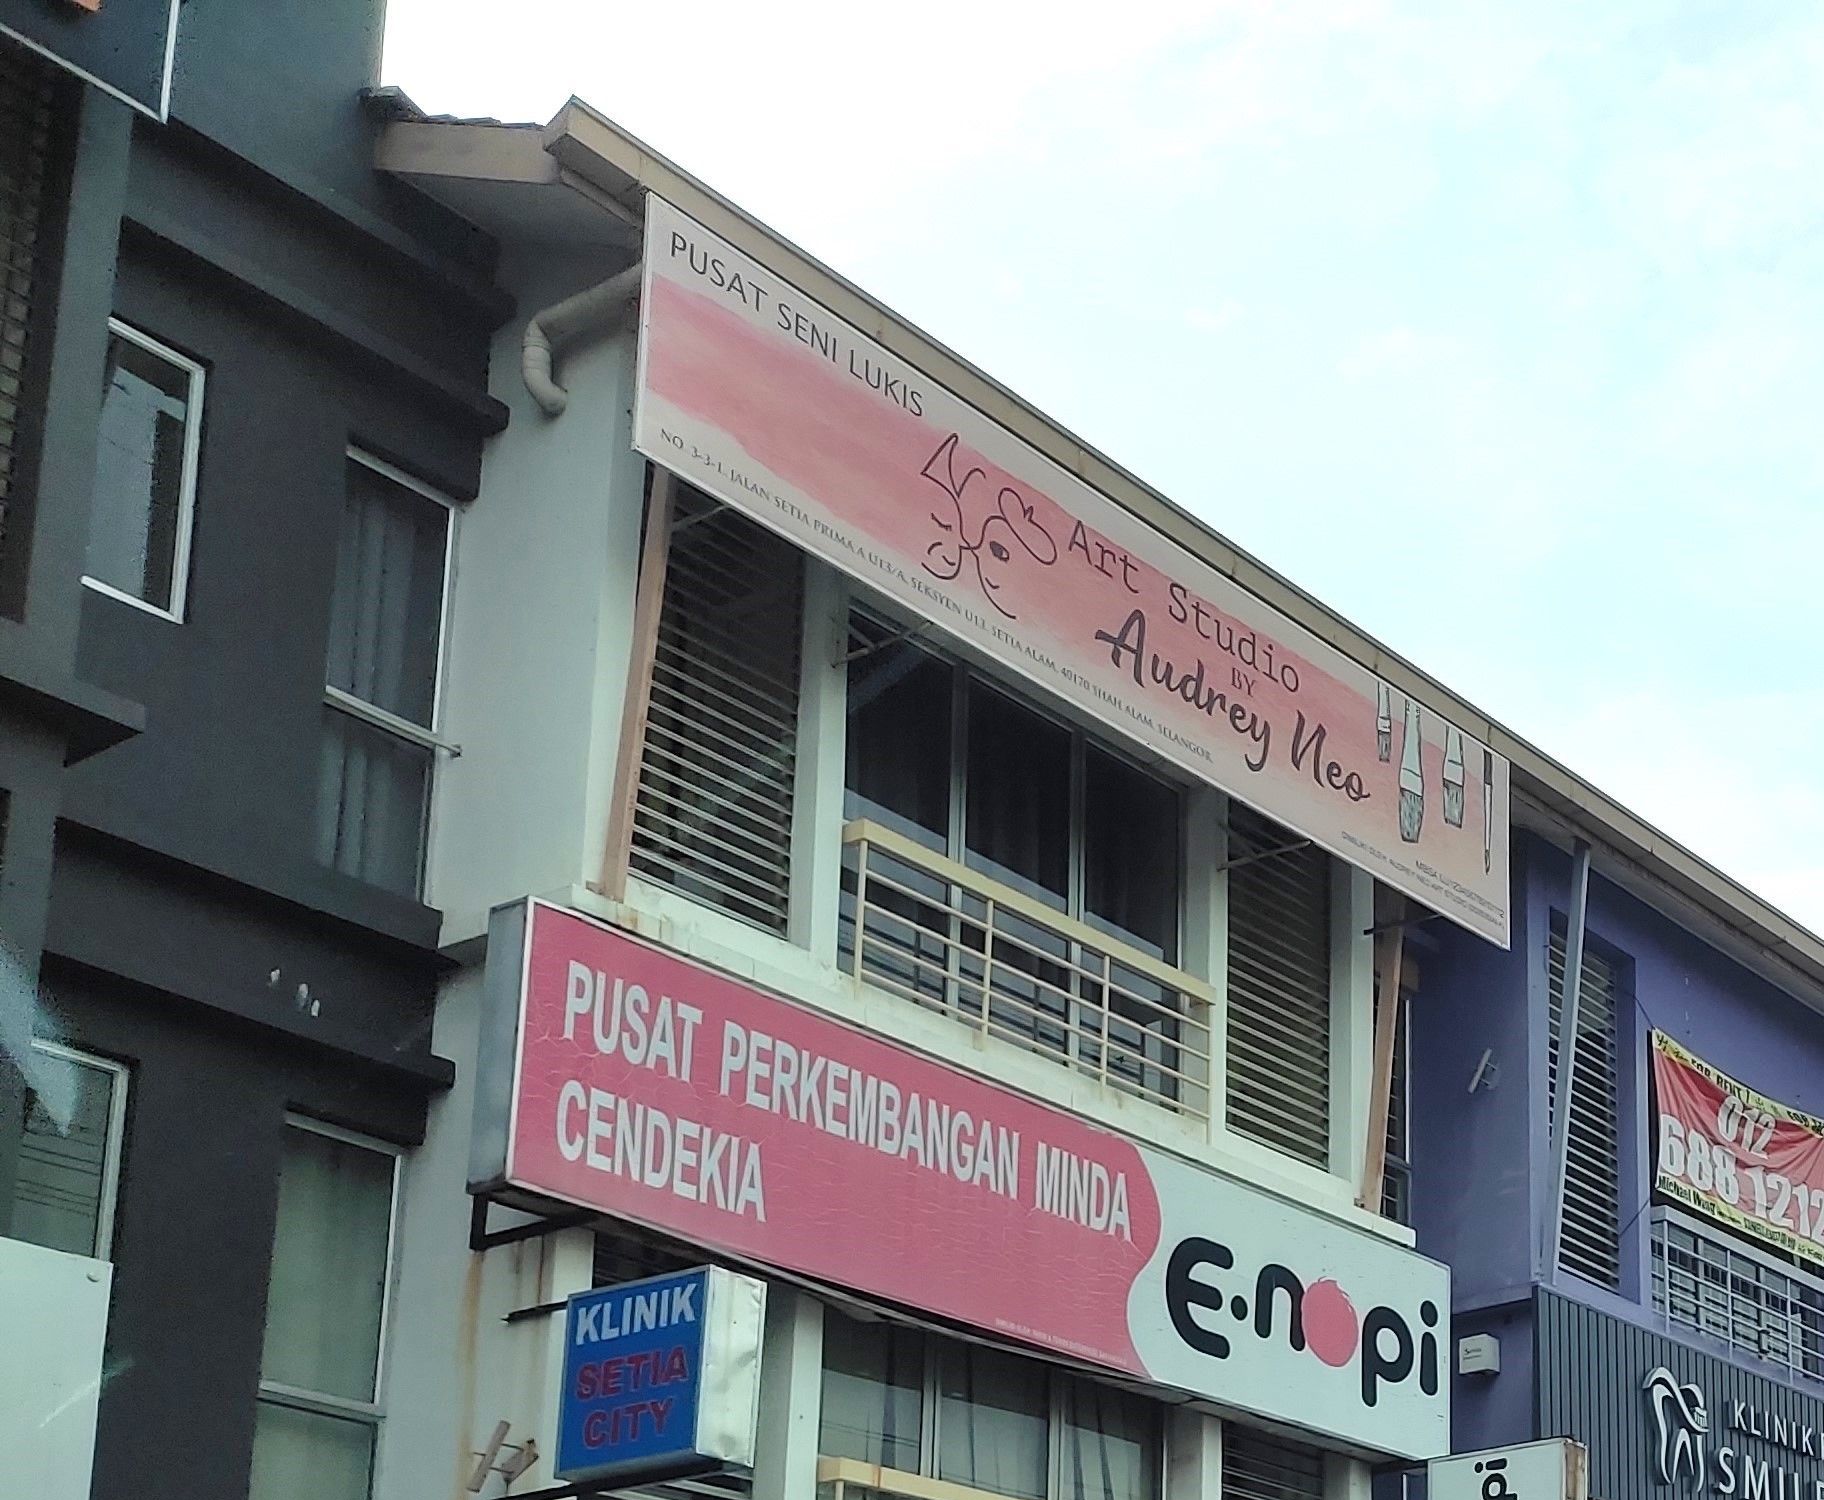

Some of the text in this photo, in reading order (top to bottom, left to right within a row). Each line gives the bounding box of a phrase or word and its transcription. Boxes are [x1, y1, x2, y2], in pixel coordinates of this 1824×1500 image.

[671, 232, 922, 416] PUSAT SENI LUKIS
[730, 469, 770, 501] JALAN
[774, 496, 810, 525] SETIA
[1068, 520, 1299, 693] Art Studio
[1094, 609, 1370, 802] Audrey Neo
[1232, 667, 1256, 697] BY
[563, 959, 1132, 1242] PUSAT PERKEMBANGAN MINDA
[556, 1080, 767, 1223] CENDEKIA
[1660, 1113, 1739, 1205] 688
[575, 1283, 697, 1346] KLINIK
[575, 1344, 689, 1400] SETIA
[583, 1396, 673, 1450] CITY
[1734, 1399, 1814, 1456] KLINIK
